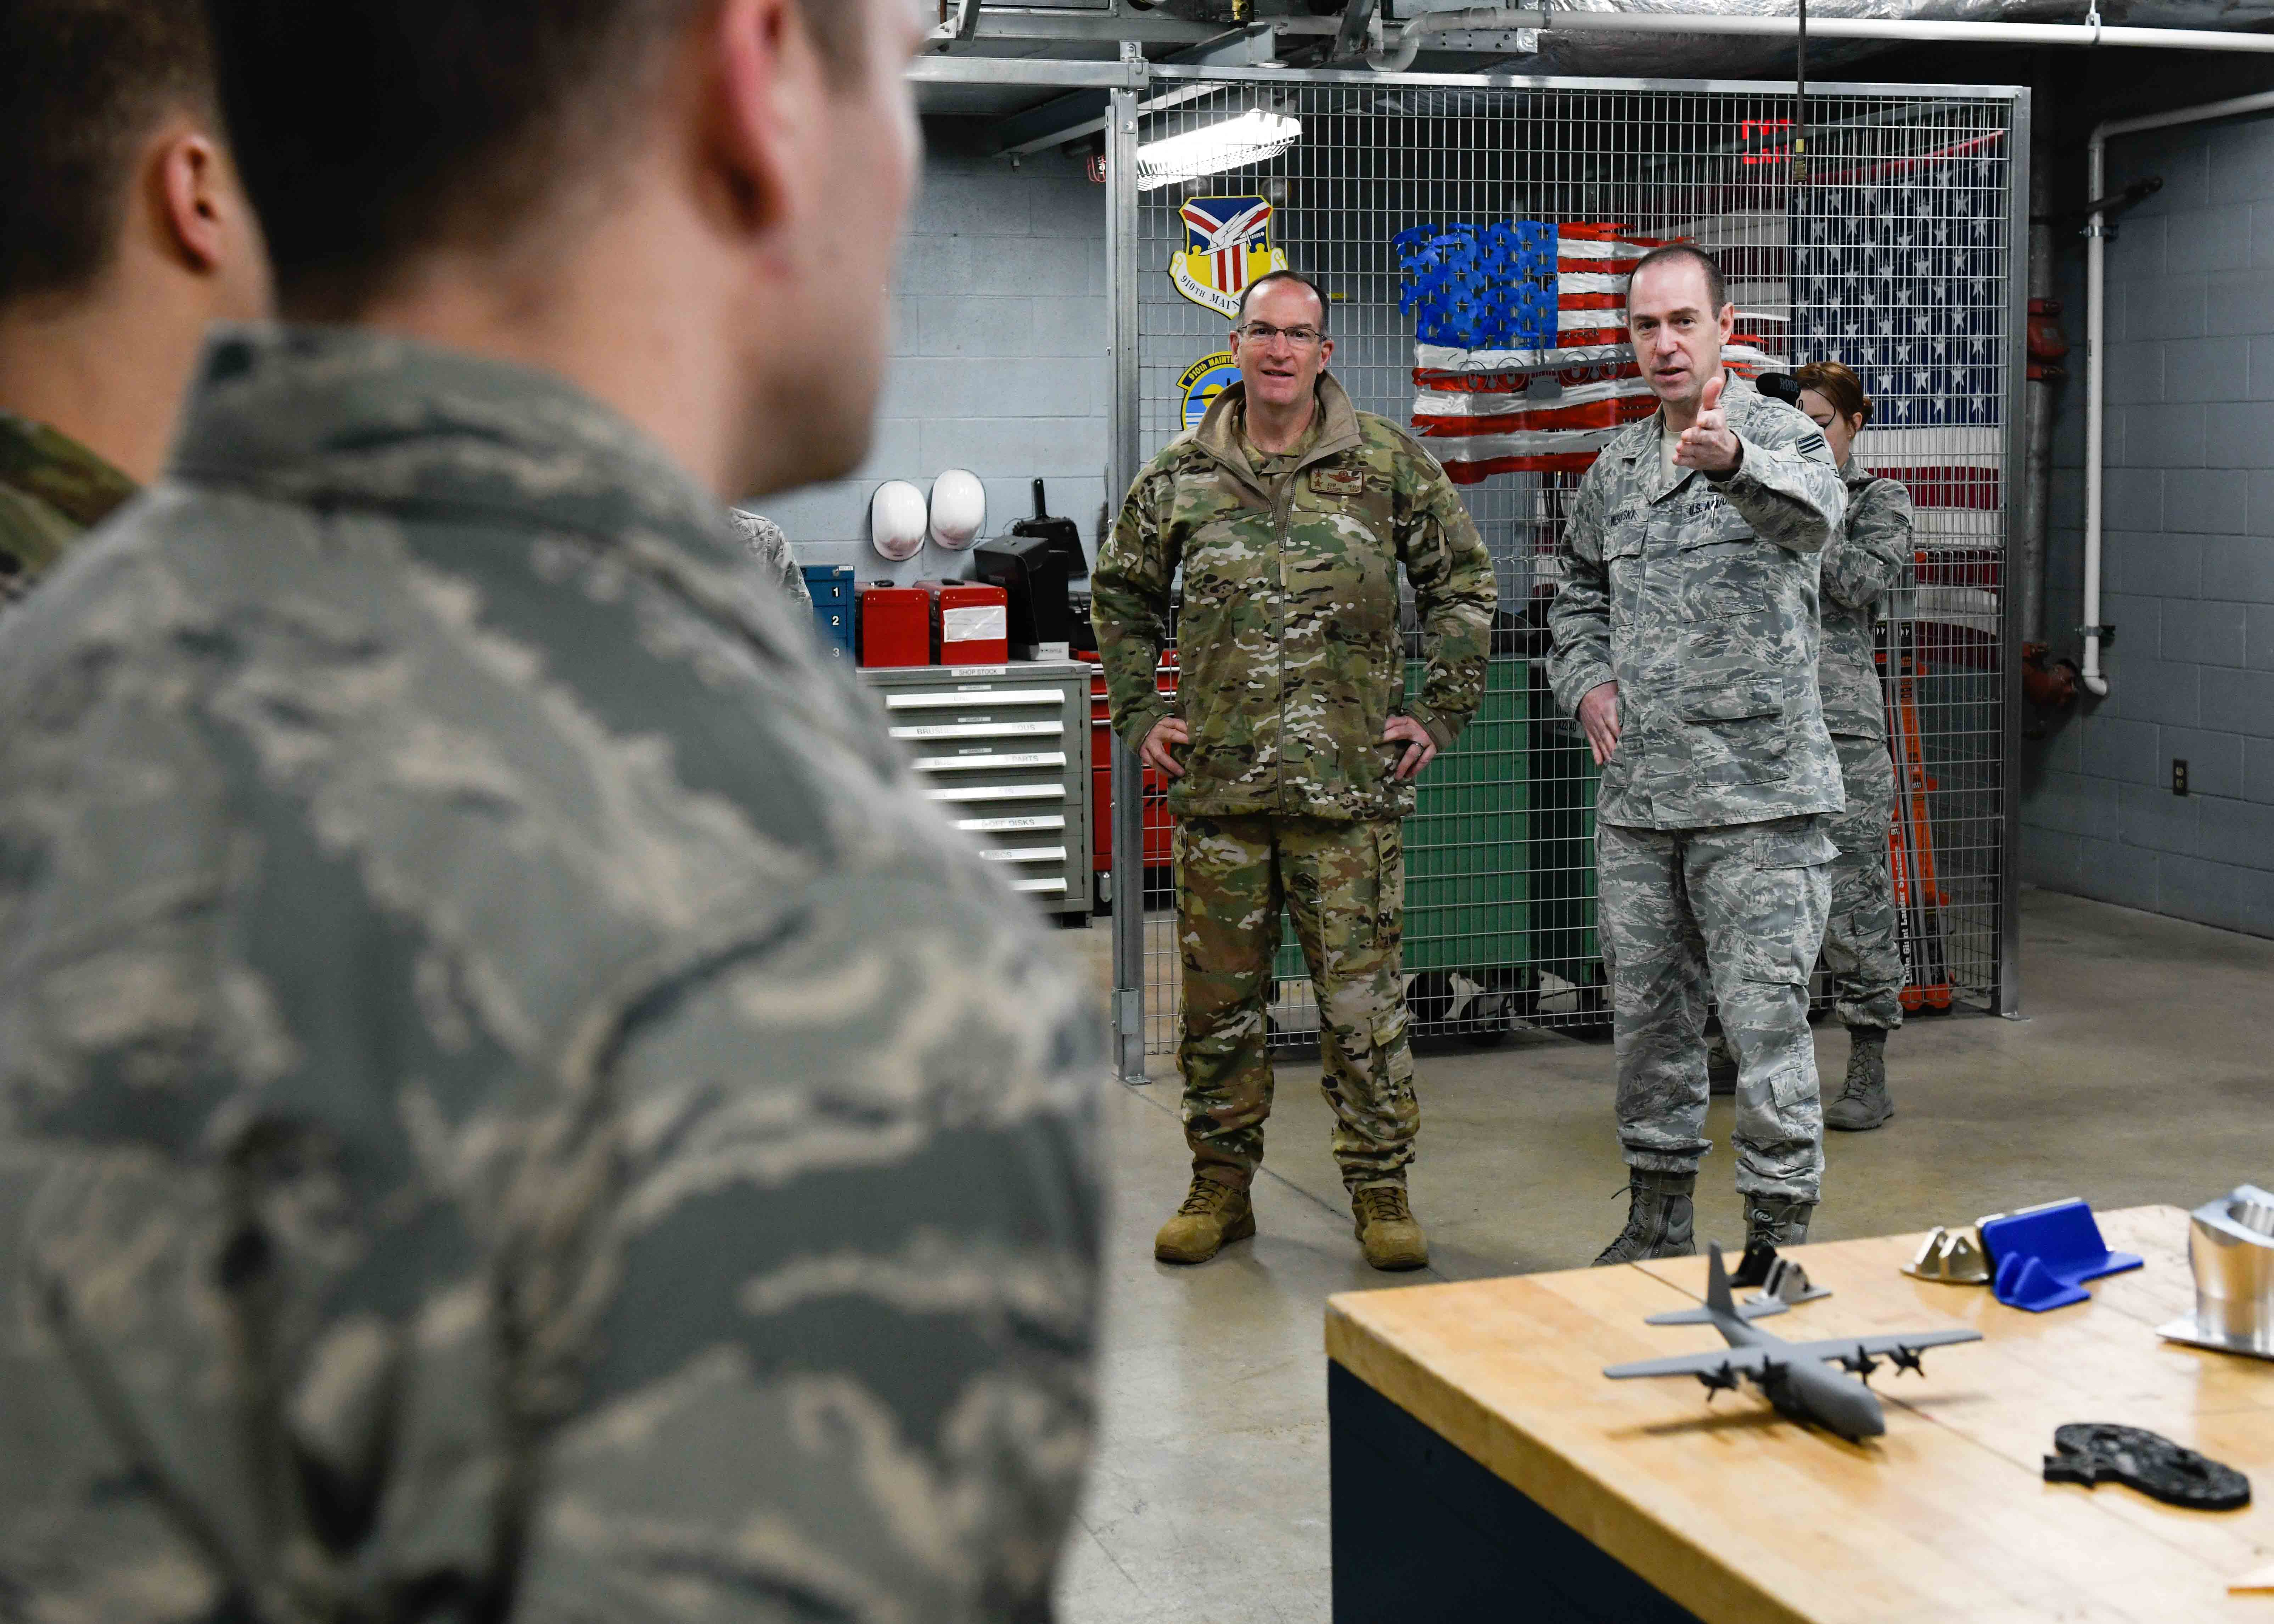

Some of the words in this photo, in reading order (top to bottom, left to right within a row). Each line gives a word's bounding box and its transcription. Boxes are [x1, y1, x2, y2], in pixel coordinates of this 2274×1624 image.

[1180, 275, 1206, 298] 910TH
[1188, 363, 1208, 380] 910th
[833, 587, 838, 597] 1
[832, 616, 839, 625] 2
[833, 648, 840, 657] 3
